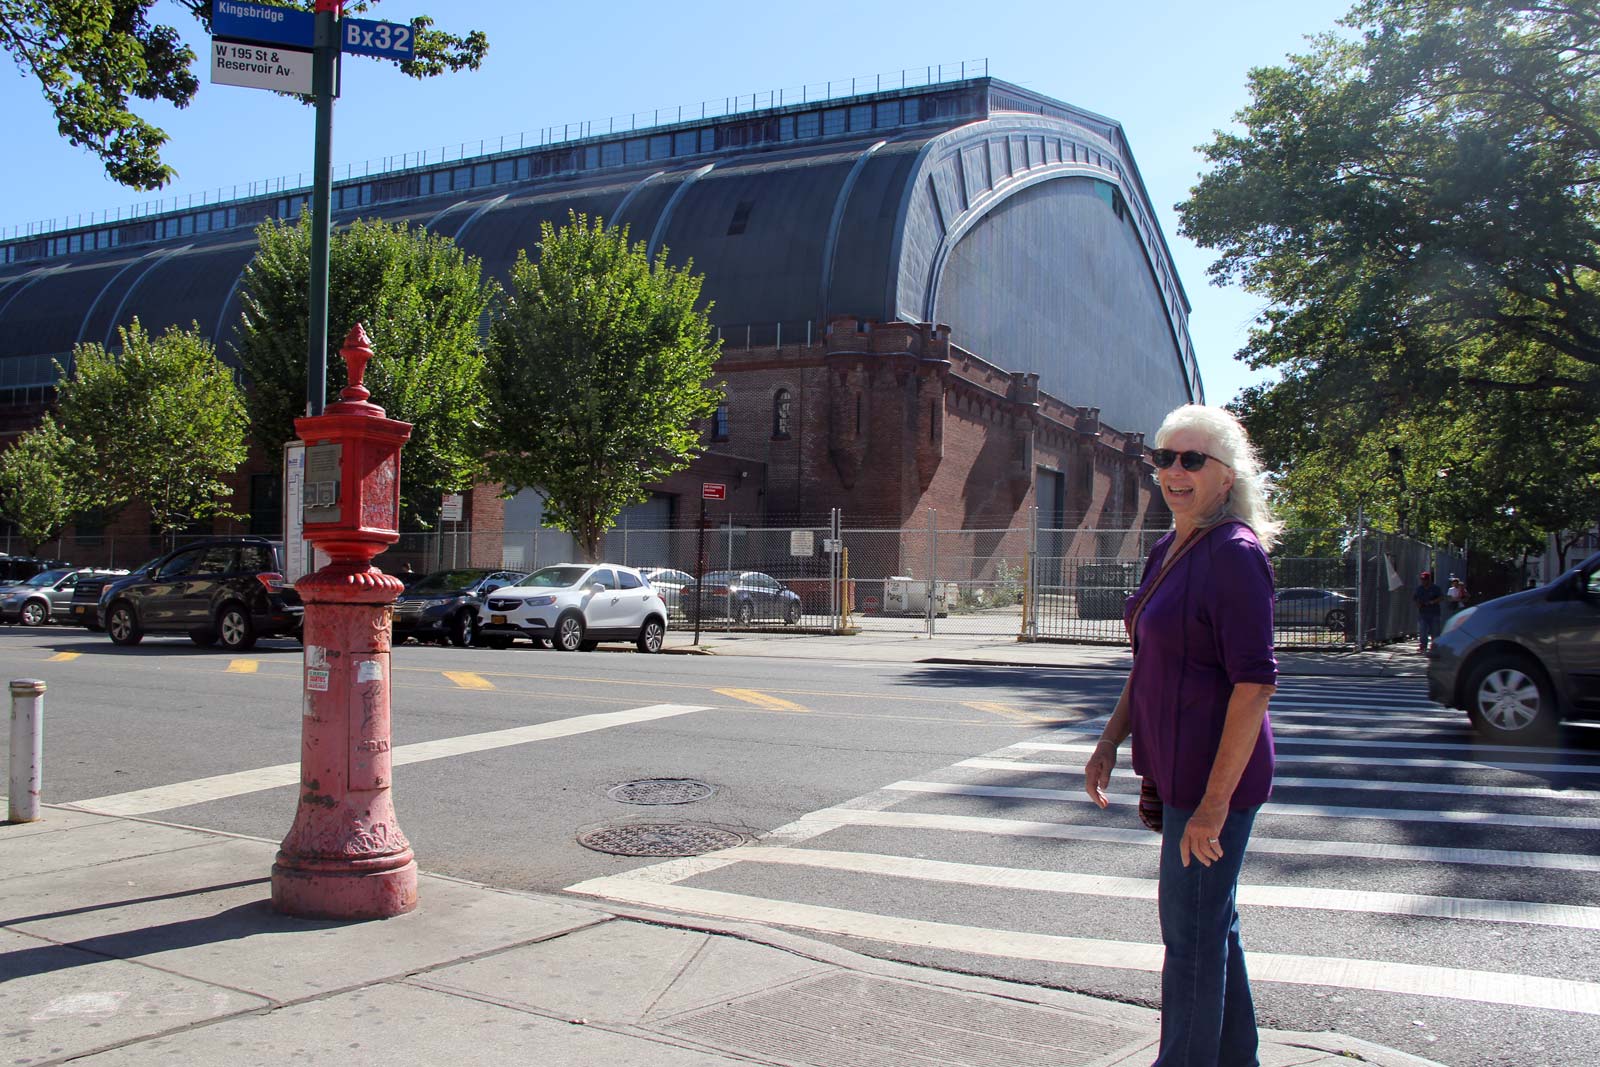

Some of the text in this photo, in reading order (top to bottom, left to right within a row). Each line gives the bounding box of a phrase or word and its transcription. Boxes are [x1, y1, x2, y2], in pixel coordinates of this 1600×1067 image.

[218, 2, 284, 23] Kingsbridge
[347, 24, 410, 52] Bx32
[216, 45, 280, 63] W 195 St &
[217, 57, 290, 76] Reservoir Av
